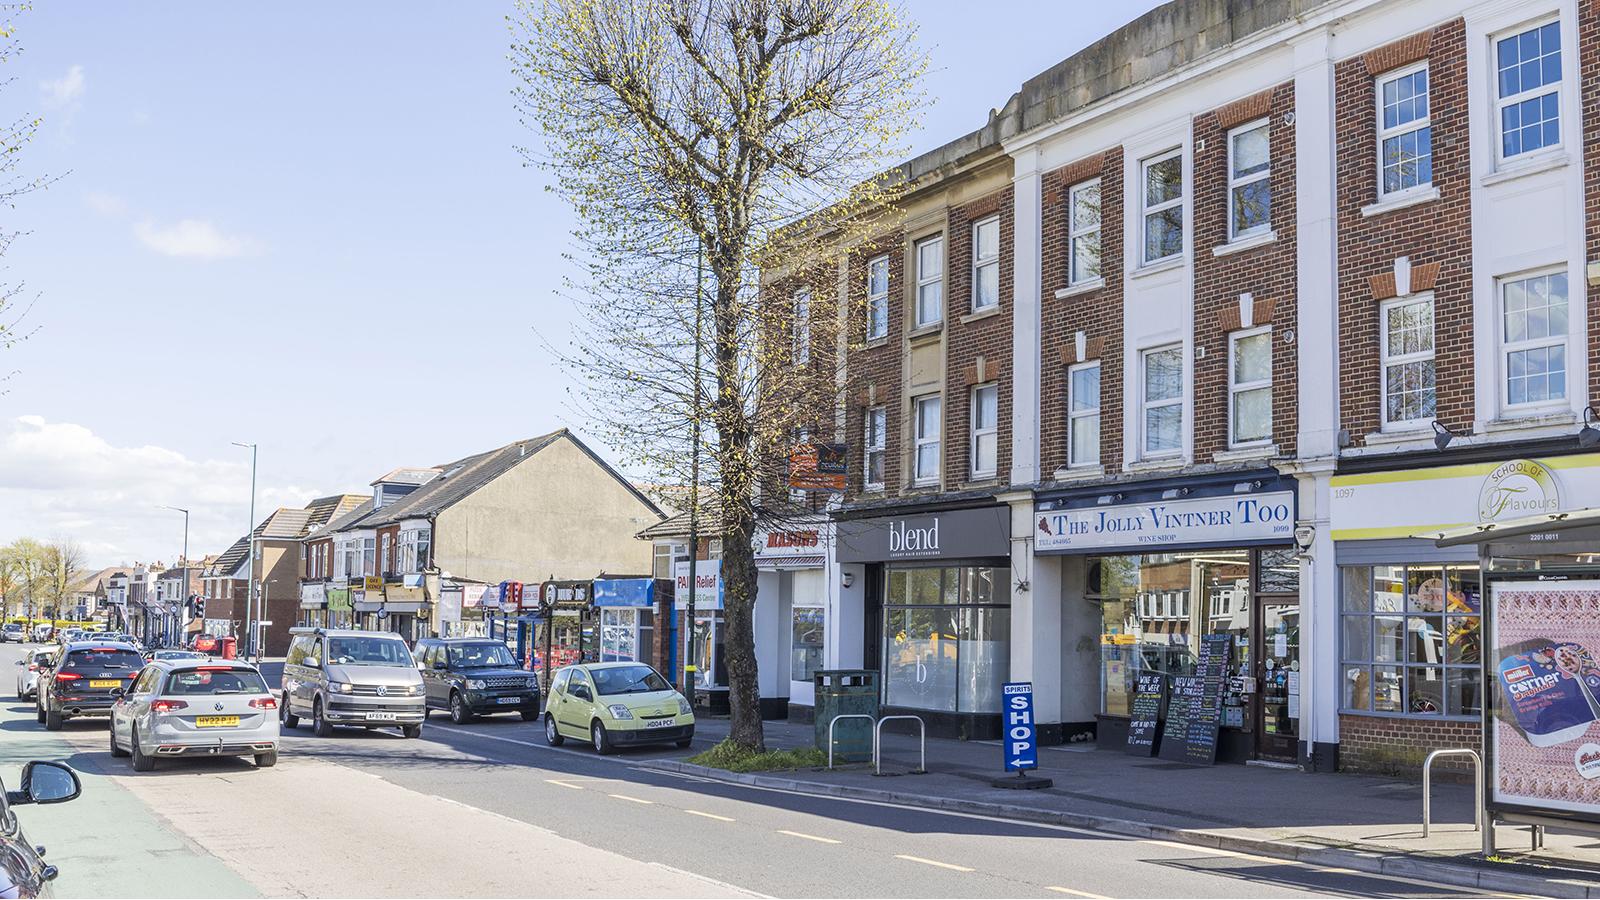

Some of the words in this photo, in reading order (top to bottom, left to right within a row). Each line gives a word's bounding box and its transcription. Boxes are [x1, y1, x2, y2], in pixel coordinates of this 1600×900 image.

[1492, 463, 1528, 482] SCHOOL
[1530, 466, 1544, 477] OF
[1335, 488, 1355, 498] 1097
[1482, 486, 1558, 520] Flavours
[1053, 515, 1089, 536] THE
[1095, 512, 1145, 533] JOLLY
[1150, 506, 1232, 529] VINTNER
[1238, 500, 1289, 524] TOO
[767, 530, 819, 548] MASONS
[889, 518, 939, 551] blend
[678, 576, 693, 589] PAI
[696, 574, 716, 588] Relief
[1006, 685, 1031, 693] SPIRITS
[1010, 696, 1031, 755] SHOP
